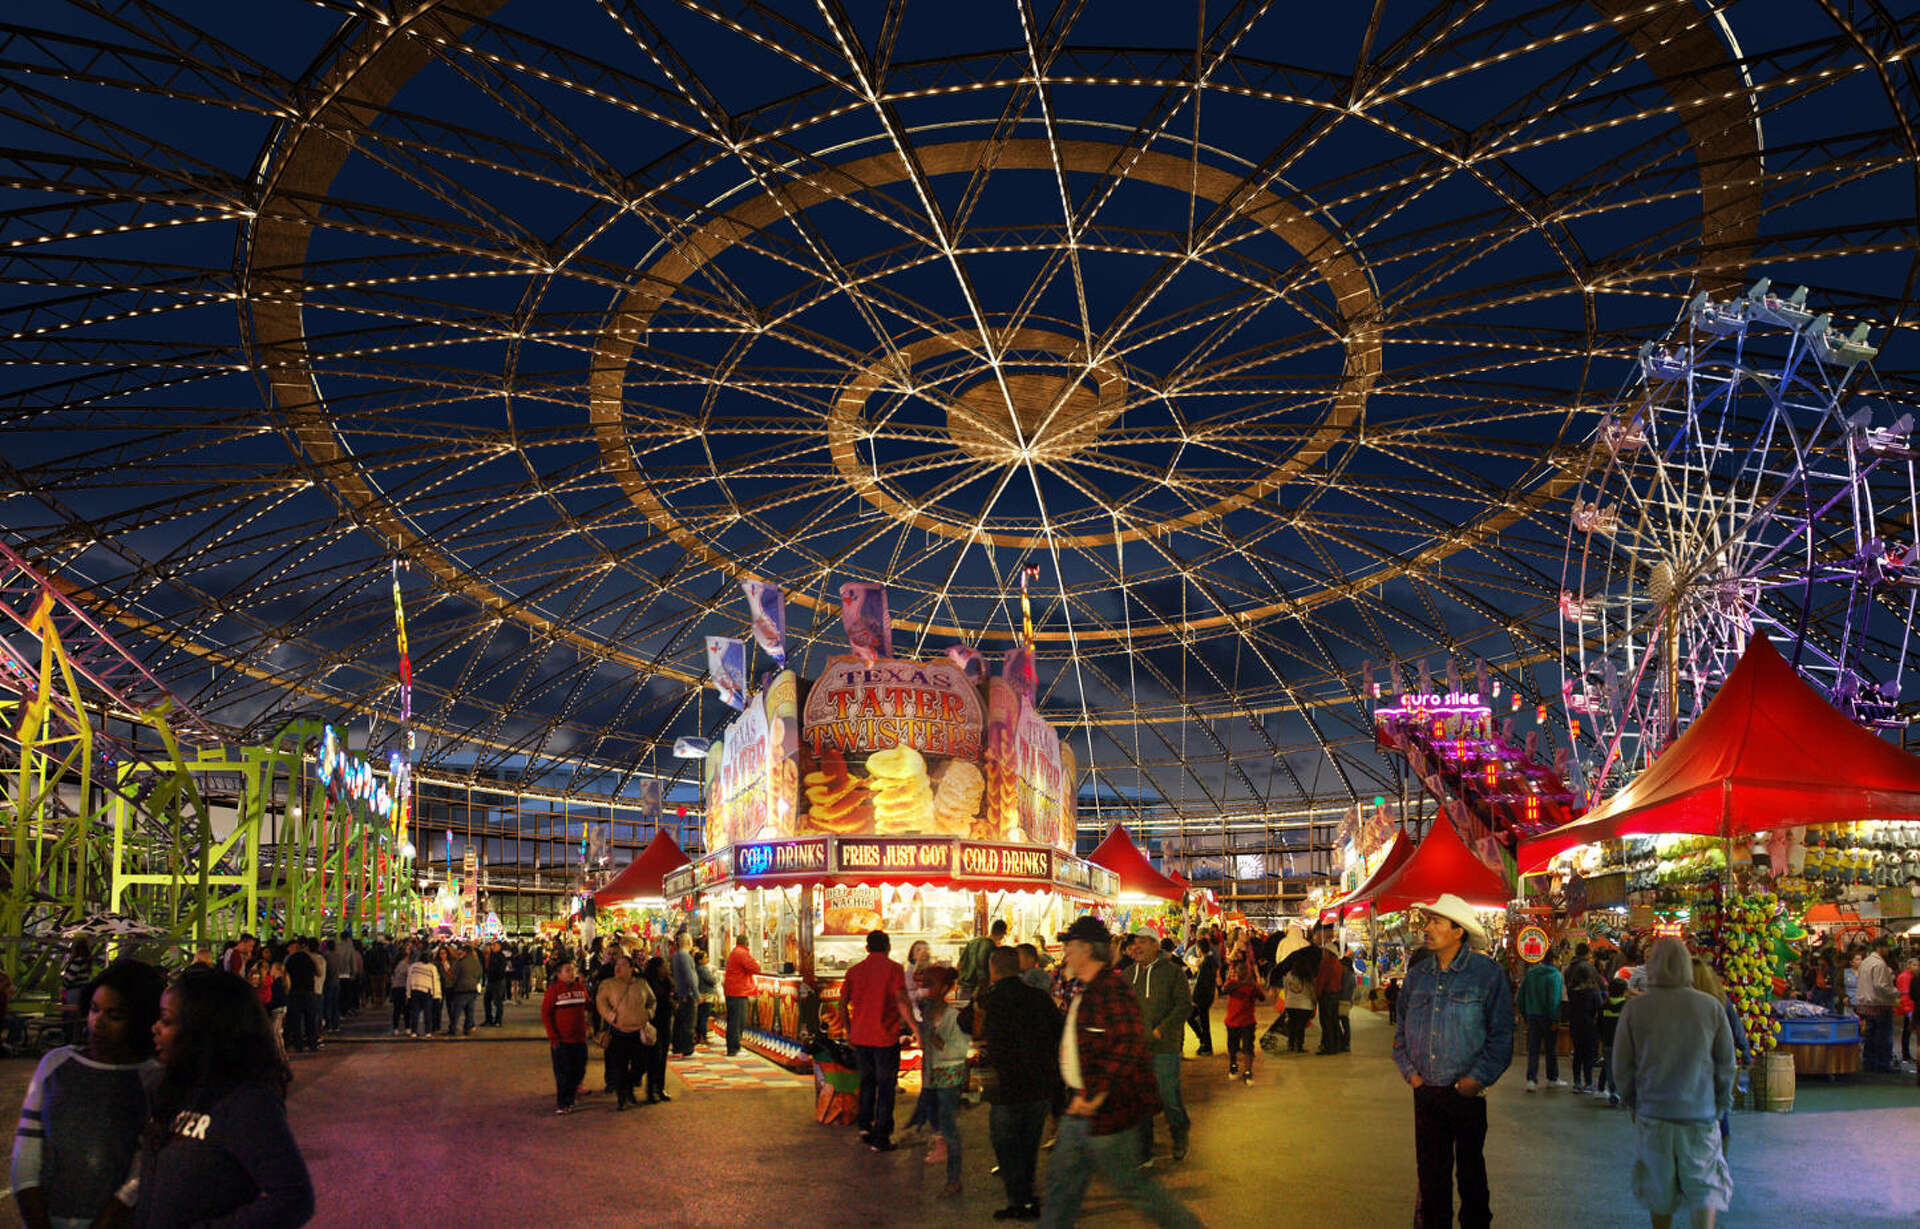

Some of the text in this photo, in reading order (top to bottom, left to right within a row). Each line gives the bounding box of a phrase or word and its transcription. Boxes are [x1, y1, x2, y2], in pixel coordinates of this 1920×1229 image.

[840, 668, 951, 688] TEXAS
[828, 687, 966, 724] TATER
[1400, 691, 1480, 706] euro slide
[806, 718, 982, 761] TWISTERS
[739, 844, 825, 873] COLD DRINKS
[842, 845, 948, 866] FRIES JUST GOT
[963, 848, 1048, 875] COLD DRINKS
